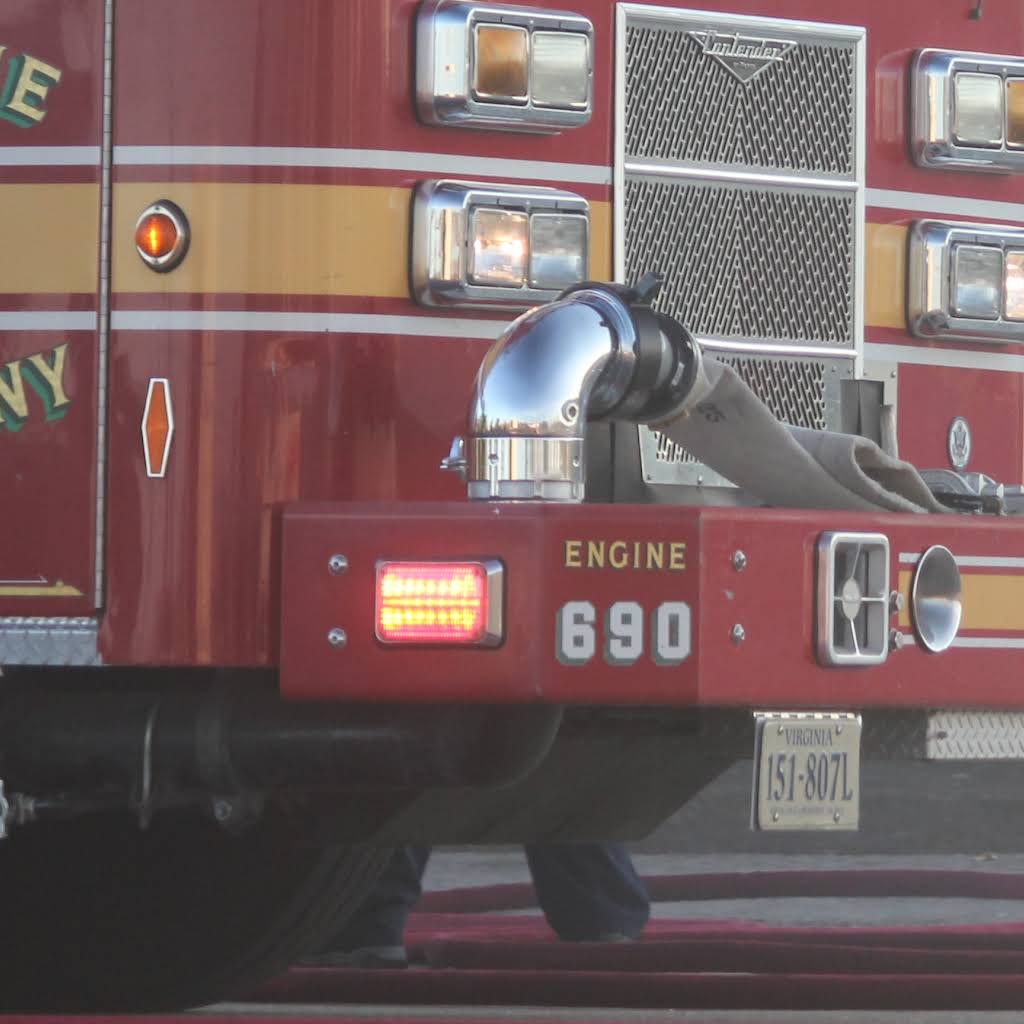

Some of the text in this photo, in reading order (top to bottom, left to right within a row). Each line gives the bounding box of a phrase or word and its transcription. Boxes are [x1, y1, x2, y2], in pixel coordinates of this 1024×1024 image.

[565, 540, 686, 569] ENGINE
[558, 600, 692, 662] 690
[785, 728, 833, 746] VIRGINIA
